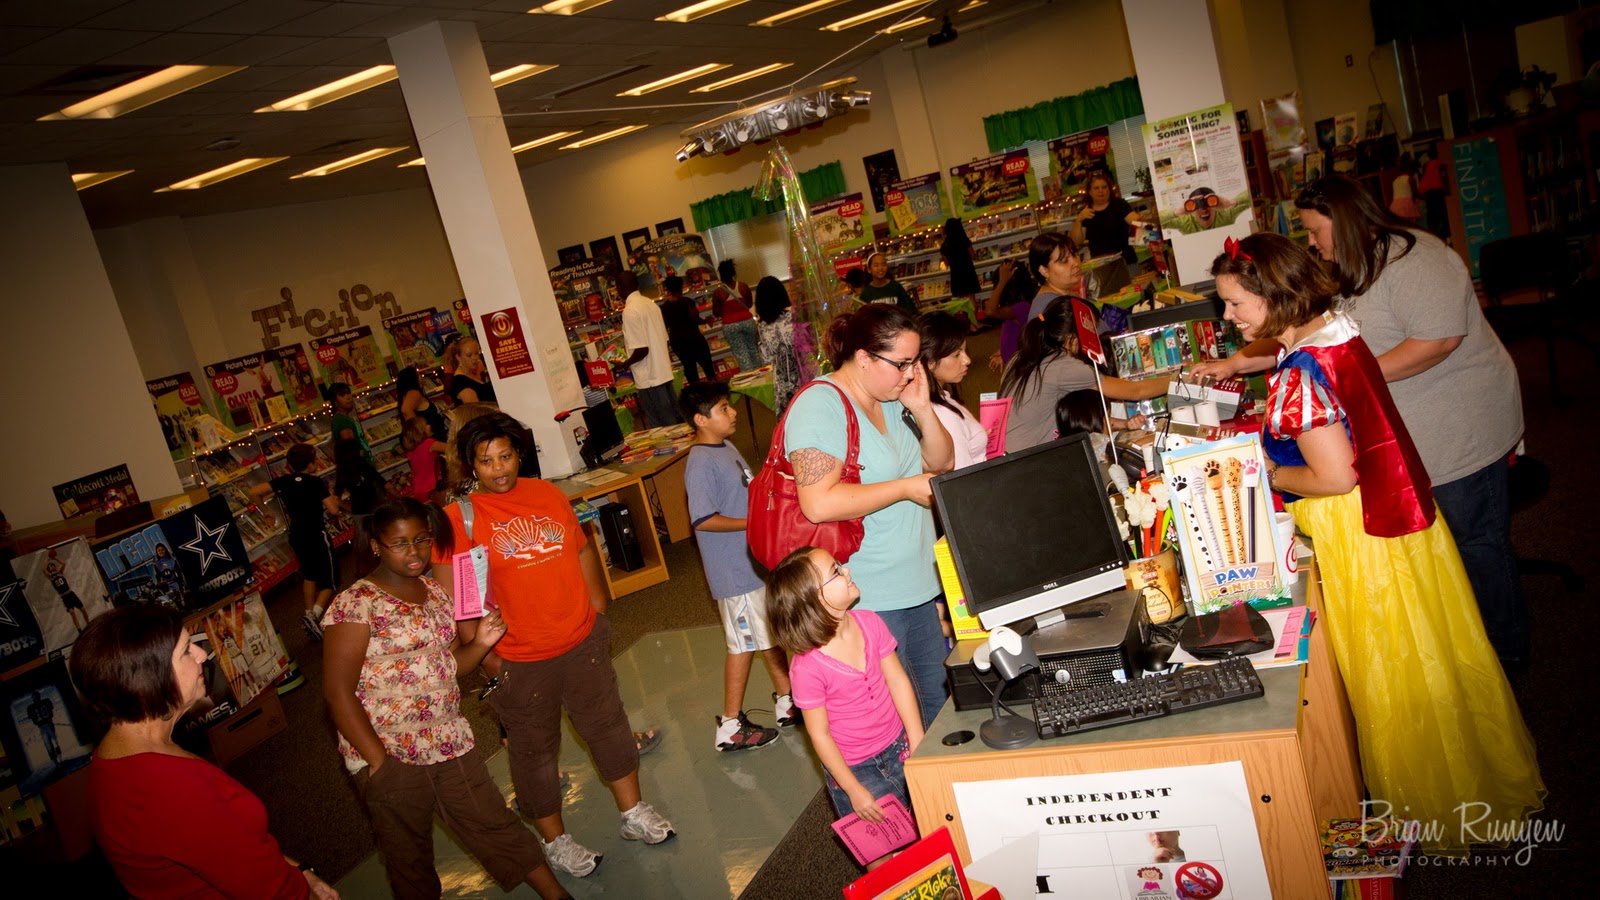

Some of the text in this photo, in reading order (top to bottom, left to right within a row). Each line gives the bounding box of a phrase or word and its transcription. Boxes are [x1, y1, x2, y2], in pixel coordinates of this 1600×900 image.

[1154, 110, 1221, 132] LOOKING FOR
[1157, 119, 1220, 140] SOMETHING?
[1090, 139, 1106, 150] READ
[1006, 160, 1026, 172] READ
[1454, 142, 1485, 232] FIND IT
[887, 191, 902, 200] READ
[841, 202, 860, 212] READ
[550, 266, 576, 277] Reading
[572, 270, 584, 278] This
[252, 284, 402, 350] Fiction
[326, 330, 360, 344] Chapter Books
[498, 338, 516, 346] SAVE
[318, 348, 336, 359] READ
[496, 343, 522, 354] ENERGY
[225, 356, 260, 370] Picture Books
[216, 375, 234, 388] READ
[180, 384, 197, 397] READ
[228, 390, 261, 408] OLIVIA
[62, 470, 128, 500] Caldecott Medal
[1214, 567, 1257, 584] PAW
[1042, 582, 1058, 590] DELL
[1210, 580, 1272, 598] POINTERS
[0, 635, 38, 656] BOYS
[251, 641, 266, 656] 21
[1026, 786, 1173, 806] INDEPENDENT
[1045, 810, 1161, 826] CHECKOUT
